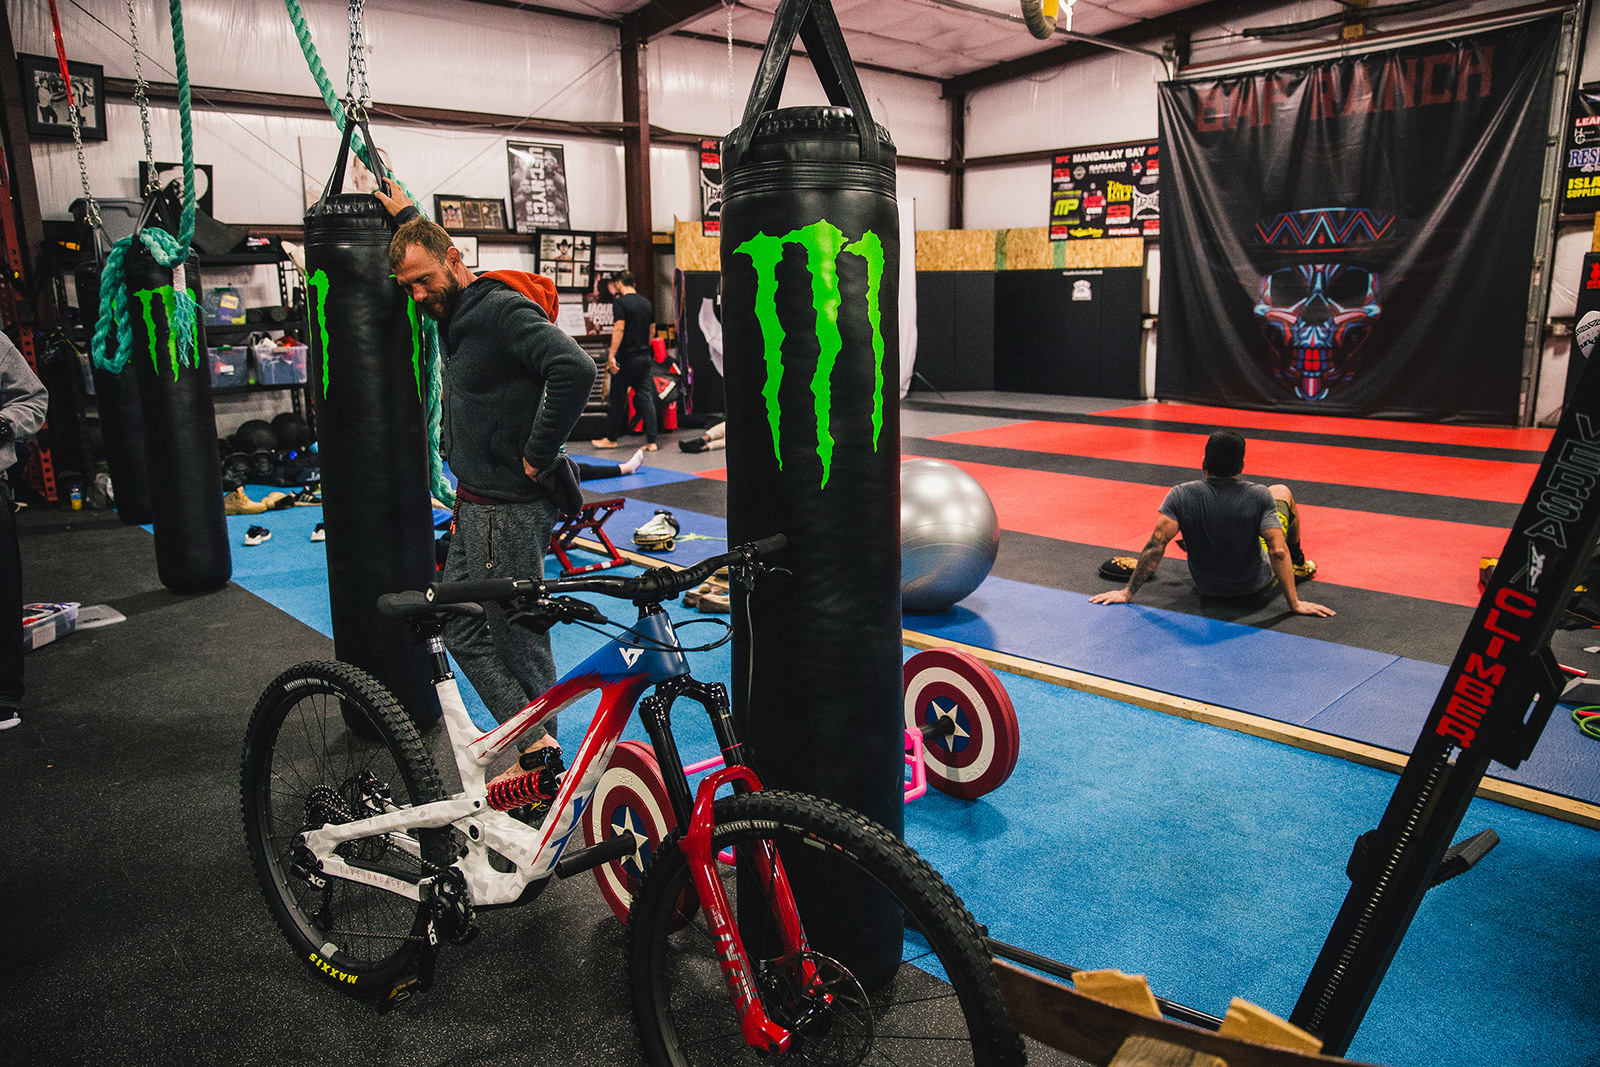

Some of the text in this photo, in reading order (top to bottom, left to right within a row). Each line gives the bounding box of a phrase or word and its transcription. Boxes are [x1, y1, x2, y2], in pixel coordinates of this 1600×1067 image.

[1310, 48, 1495, 121] RANCH
[1072, 146, 1146, 163] MANDALAY BAY
[1523, 413, 1600, 549] VERSA
[1436, 586, 1538, 749] CLIMBER
[340, 867, 407, 891] LIVE UNCAGED
[308, 952, 359, 984] MAXXIS
